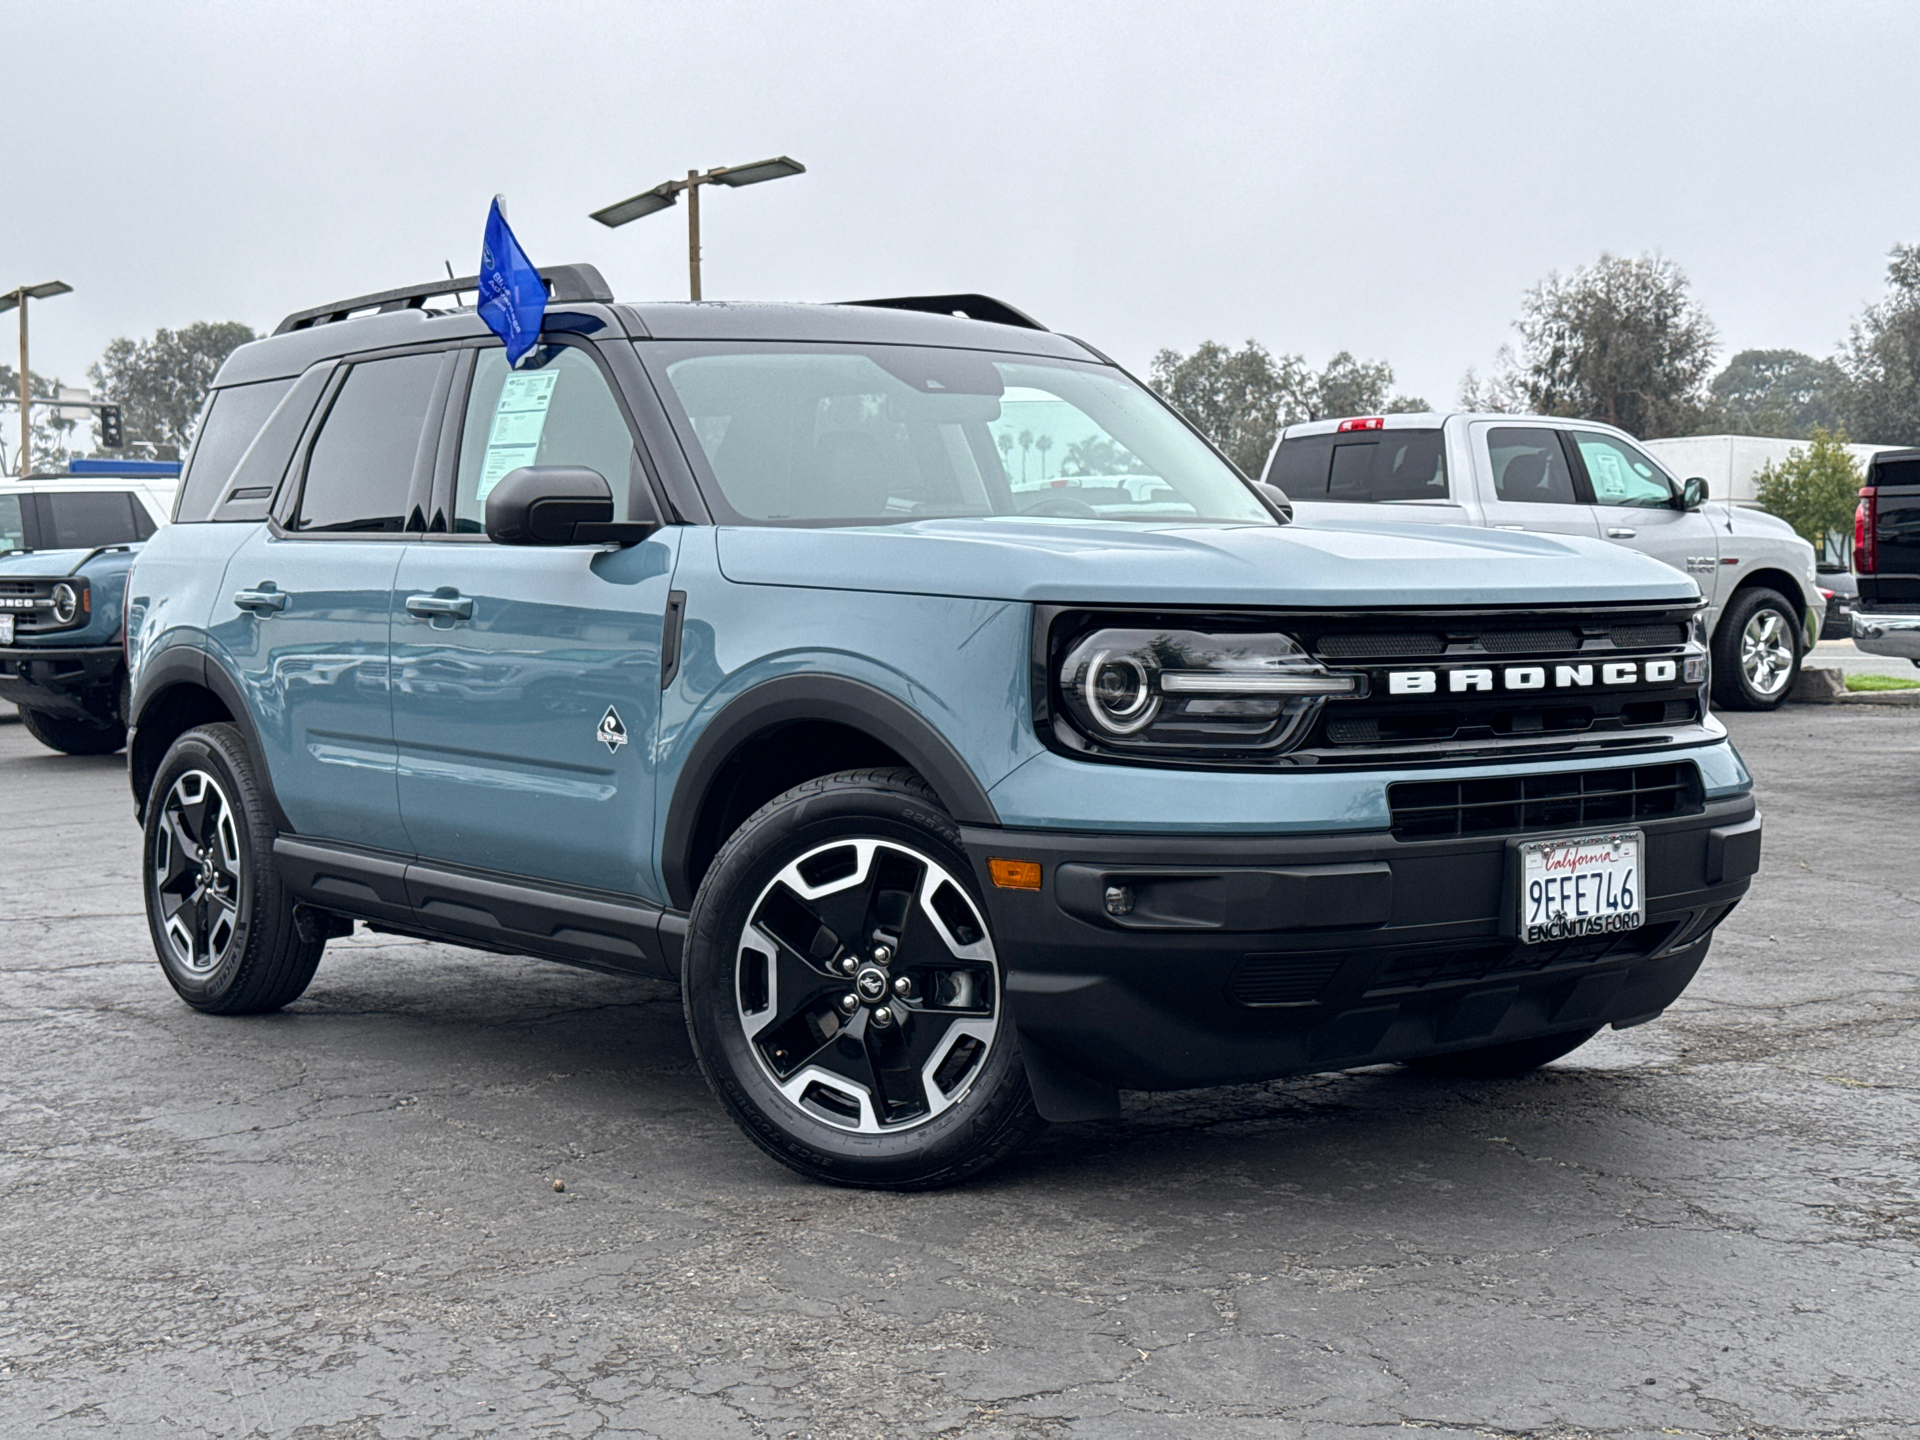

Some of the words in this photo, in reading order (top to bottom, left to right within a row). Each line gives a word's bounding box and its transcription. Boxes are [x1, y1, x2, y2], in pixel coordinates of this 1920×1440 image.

[1389, 660, 1676, 694] BRONCO
[1545, 846, 1619, 874] California
[1528, 917, 1603, 942] ENCINITAS
[1605, 912, 1640, 931] FORD
[208, 951, 237, 994] MICHELIN
